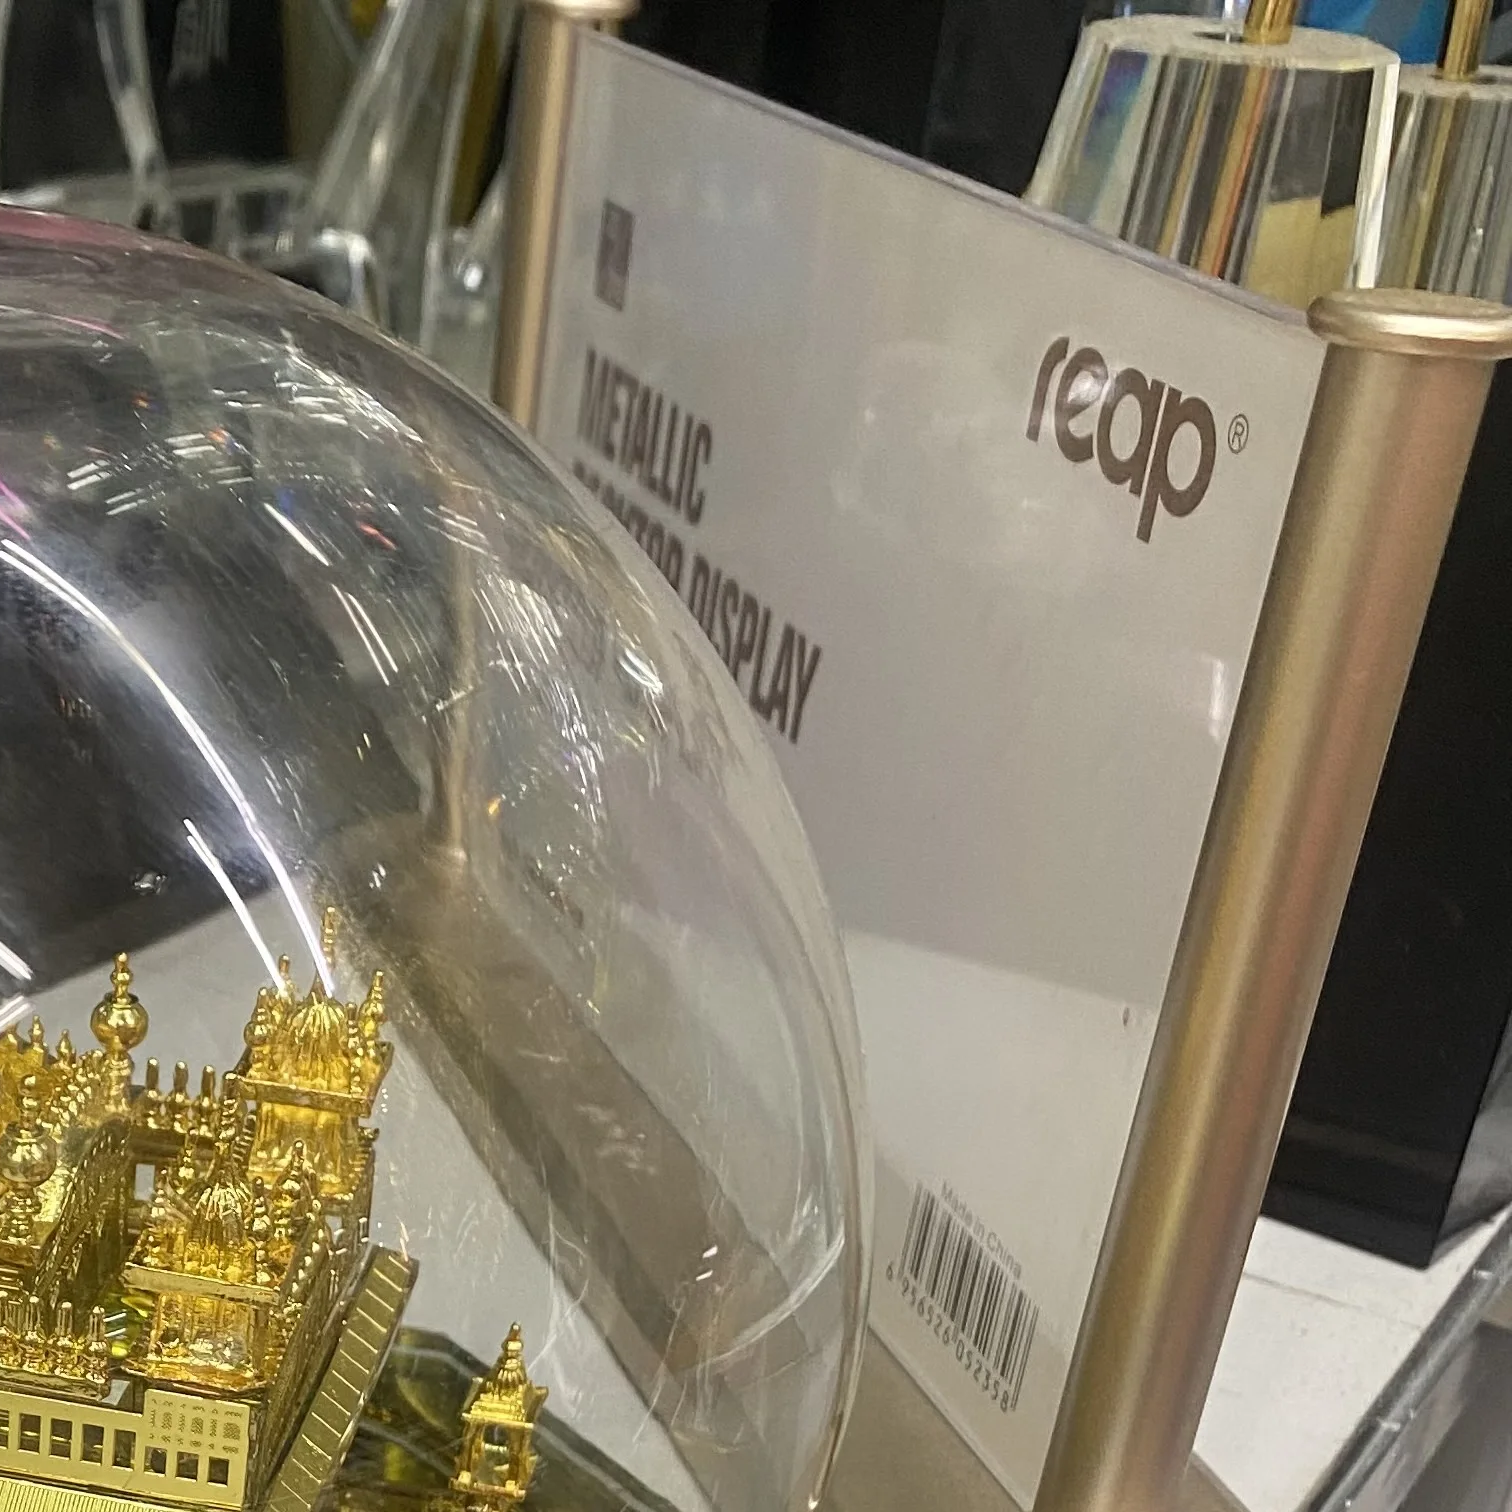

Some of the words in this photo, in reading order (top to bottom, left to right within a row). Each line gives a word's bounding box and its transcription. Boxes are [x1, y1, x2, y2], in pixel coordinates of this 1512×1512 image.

[576, 346, 712, 525] METALLIC
[689, 553, 821, 743] DISPLAY
[987, 1231, 1022, 1280] China
[955, 1338, 1010, 1413] 052358
